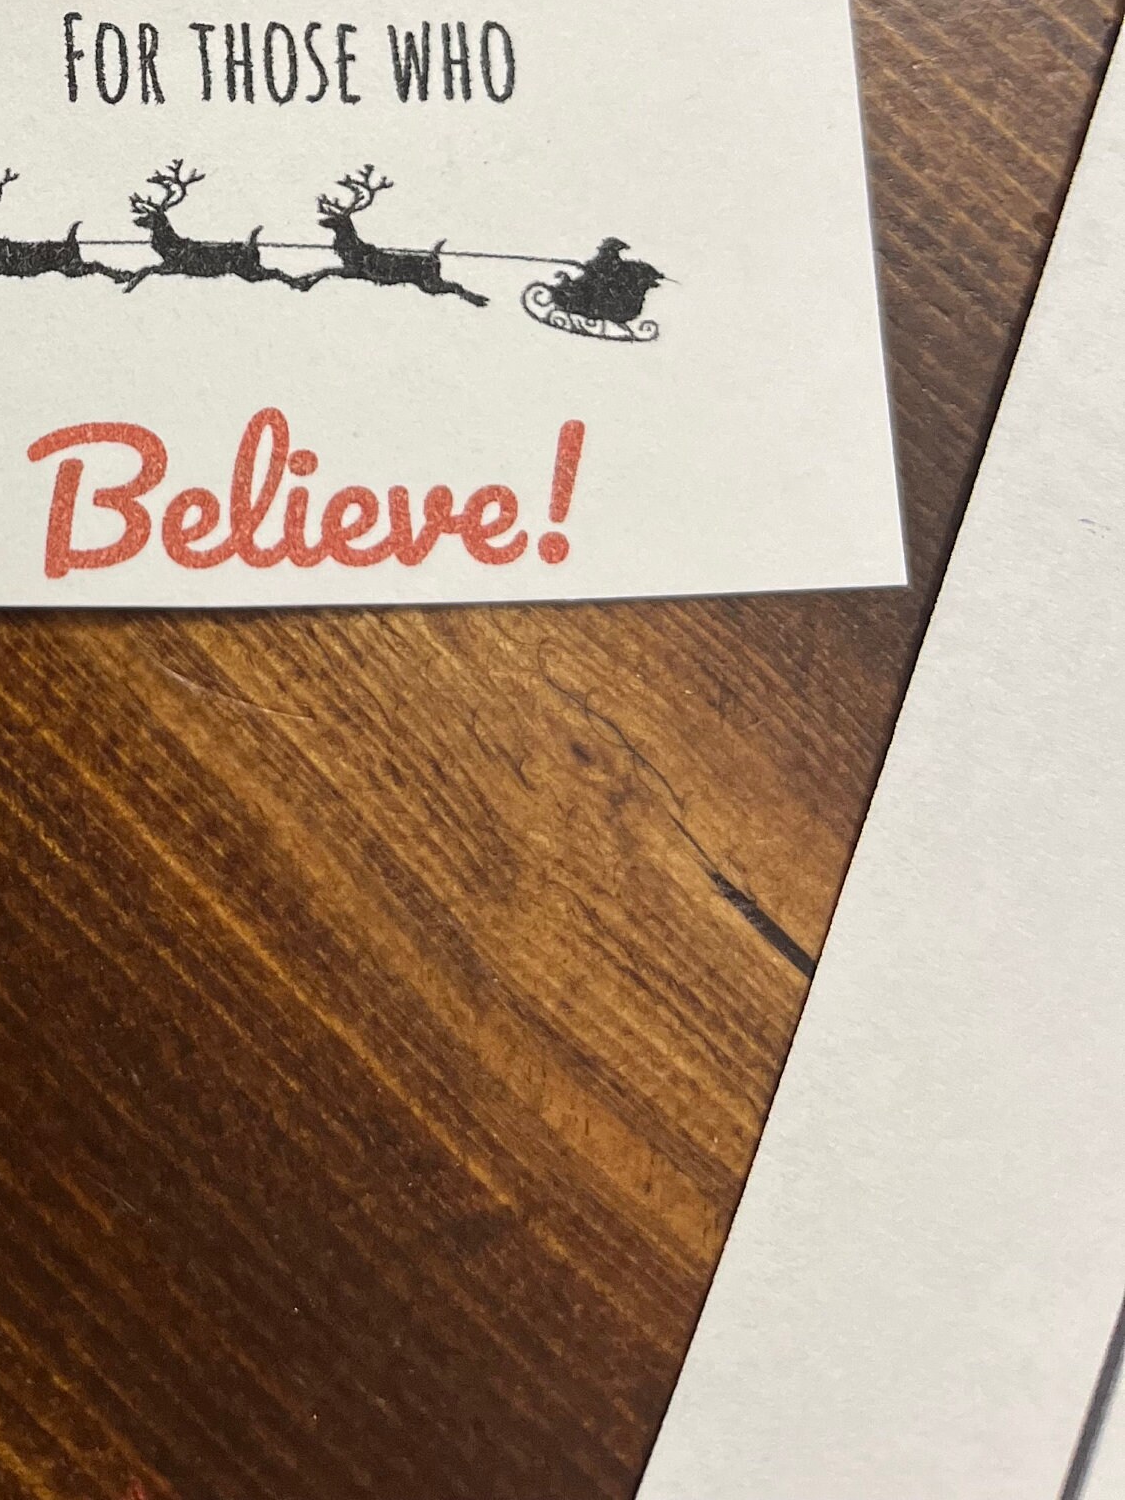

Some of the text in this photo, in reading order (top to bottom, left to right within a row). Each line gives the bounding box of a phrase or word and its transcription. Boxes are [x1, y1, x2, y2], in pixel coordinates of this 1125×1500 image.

[62, 11, 516, 107] FOR THOSE WHO
[27, 406, 586, 579] Believe!
